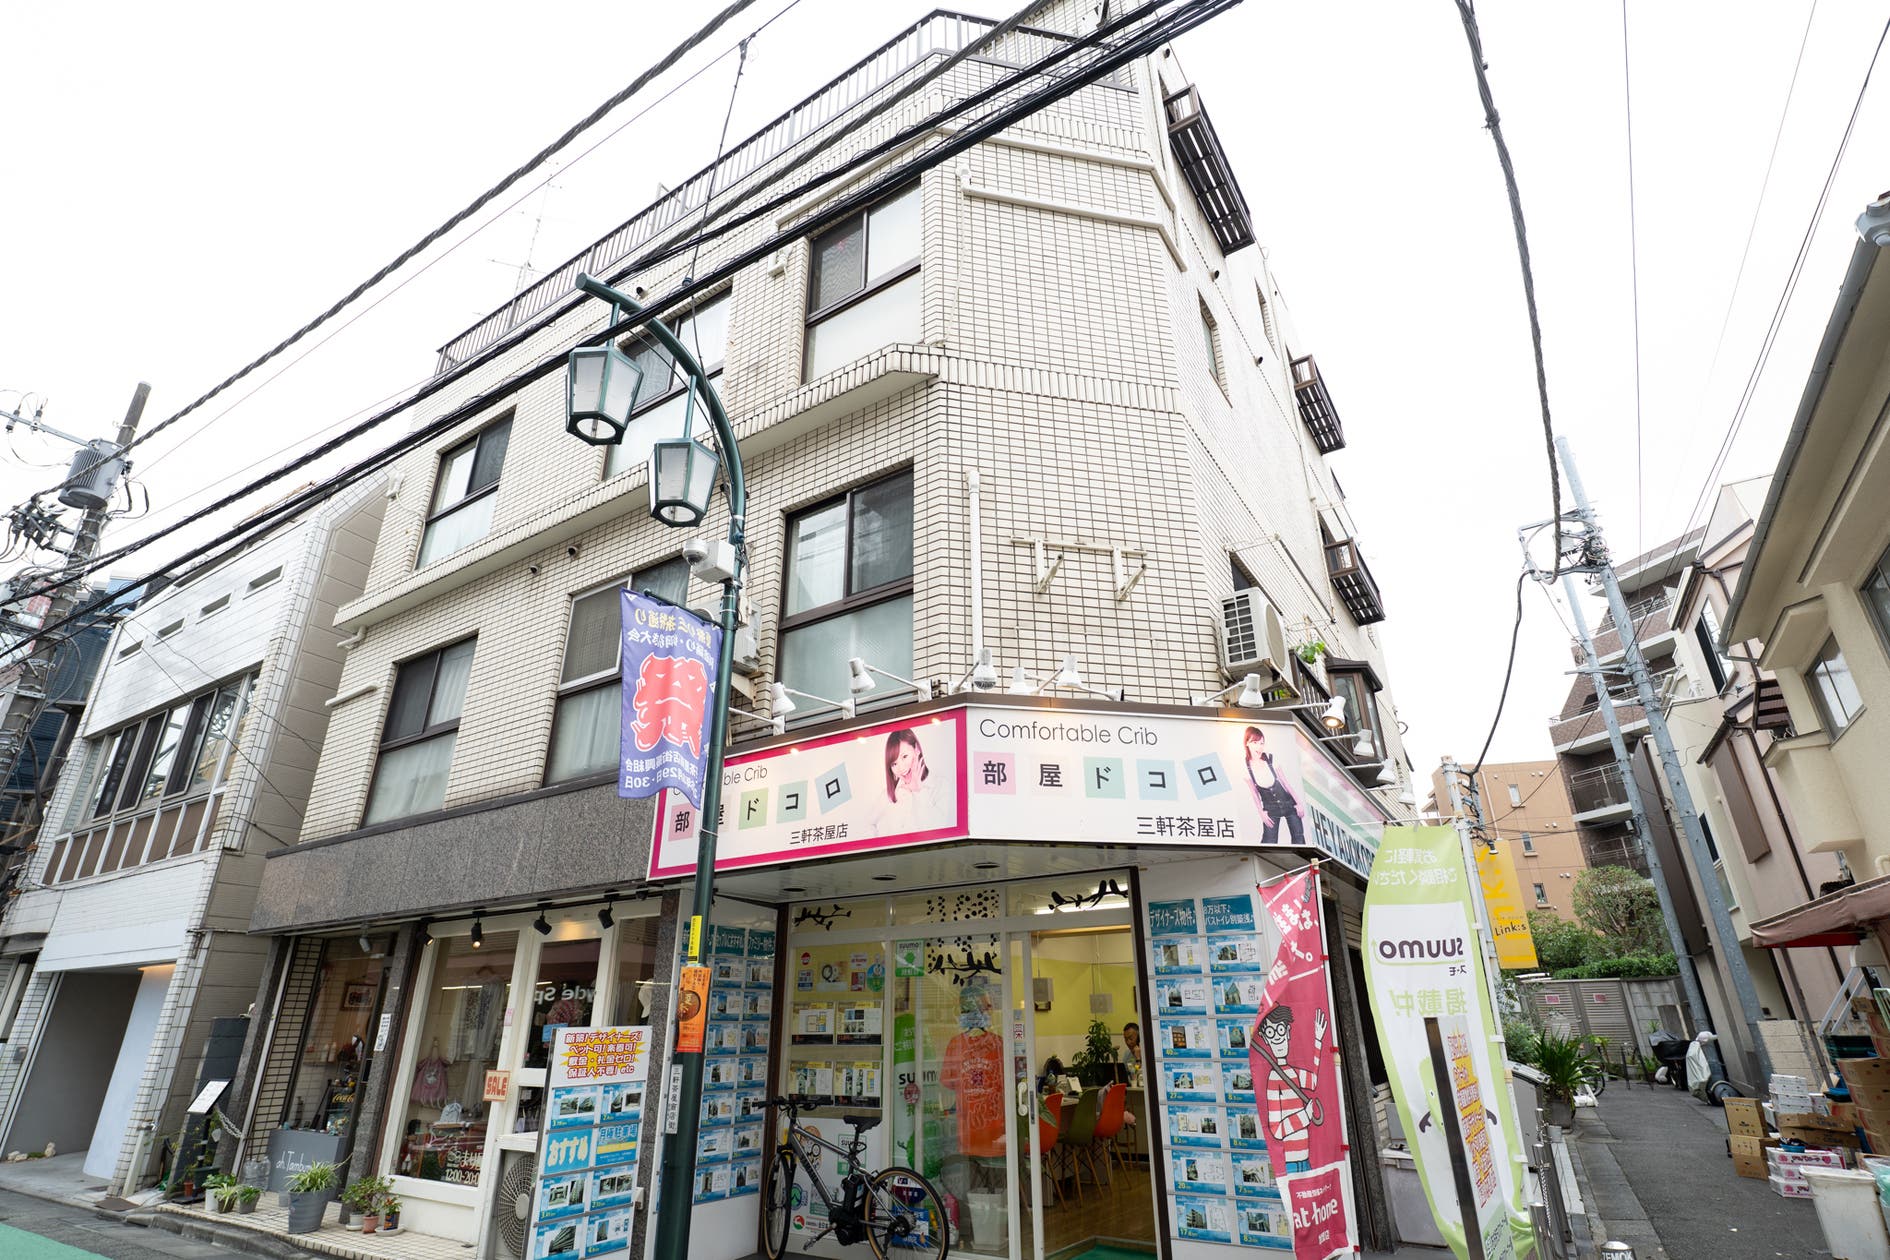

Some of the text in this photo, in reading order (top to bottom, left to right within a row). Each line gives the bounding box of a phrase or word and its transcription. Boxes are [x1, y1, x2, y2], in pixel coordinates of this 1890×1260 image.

[979, 718, 1158, 746] Comfortable Crib
[744, 765, 768, 783] Crib
[982, 760, 1217, 790] 部屋ドコロ
[789, 823, 848, 845] 三軒茶屋店
[1136, 816, 1235, 838] 三軒茶屋店
[1495, 922, 1527, 937] Link:s
[486, 1076, 507, 1097] SALE
[547, 1136, 588, 1167] おすすめ
[1293, 1198, 1338, 1229] at home
